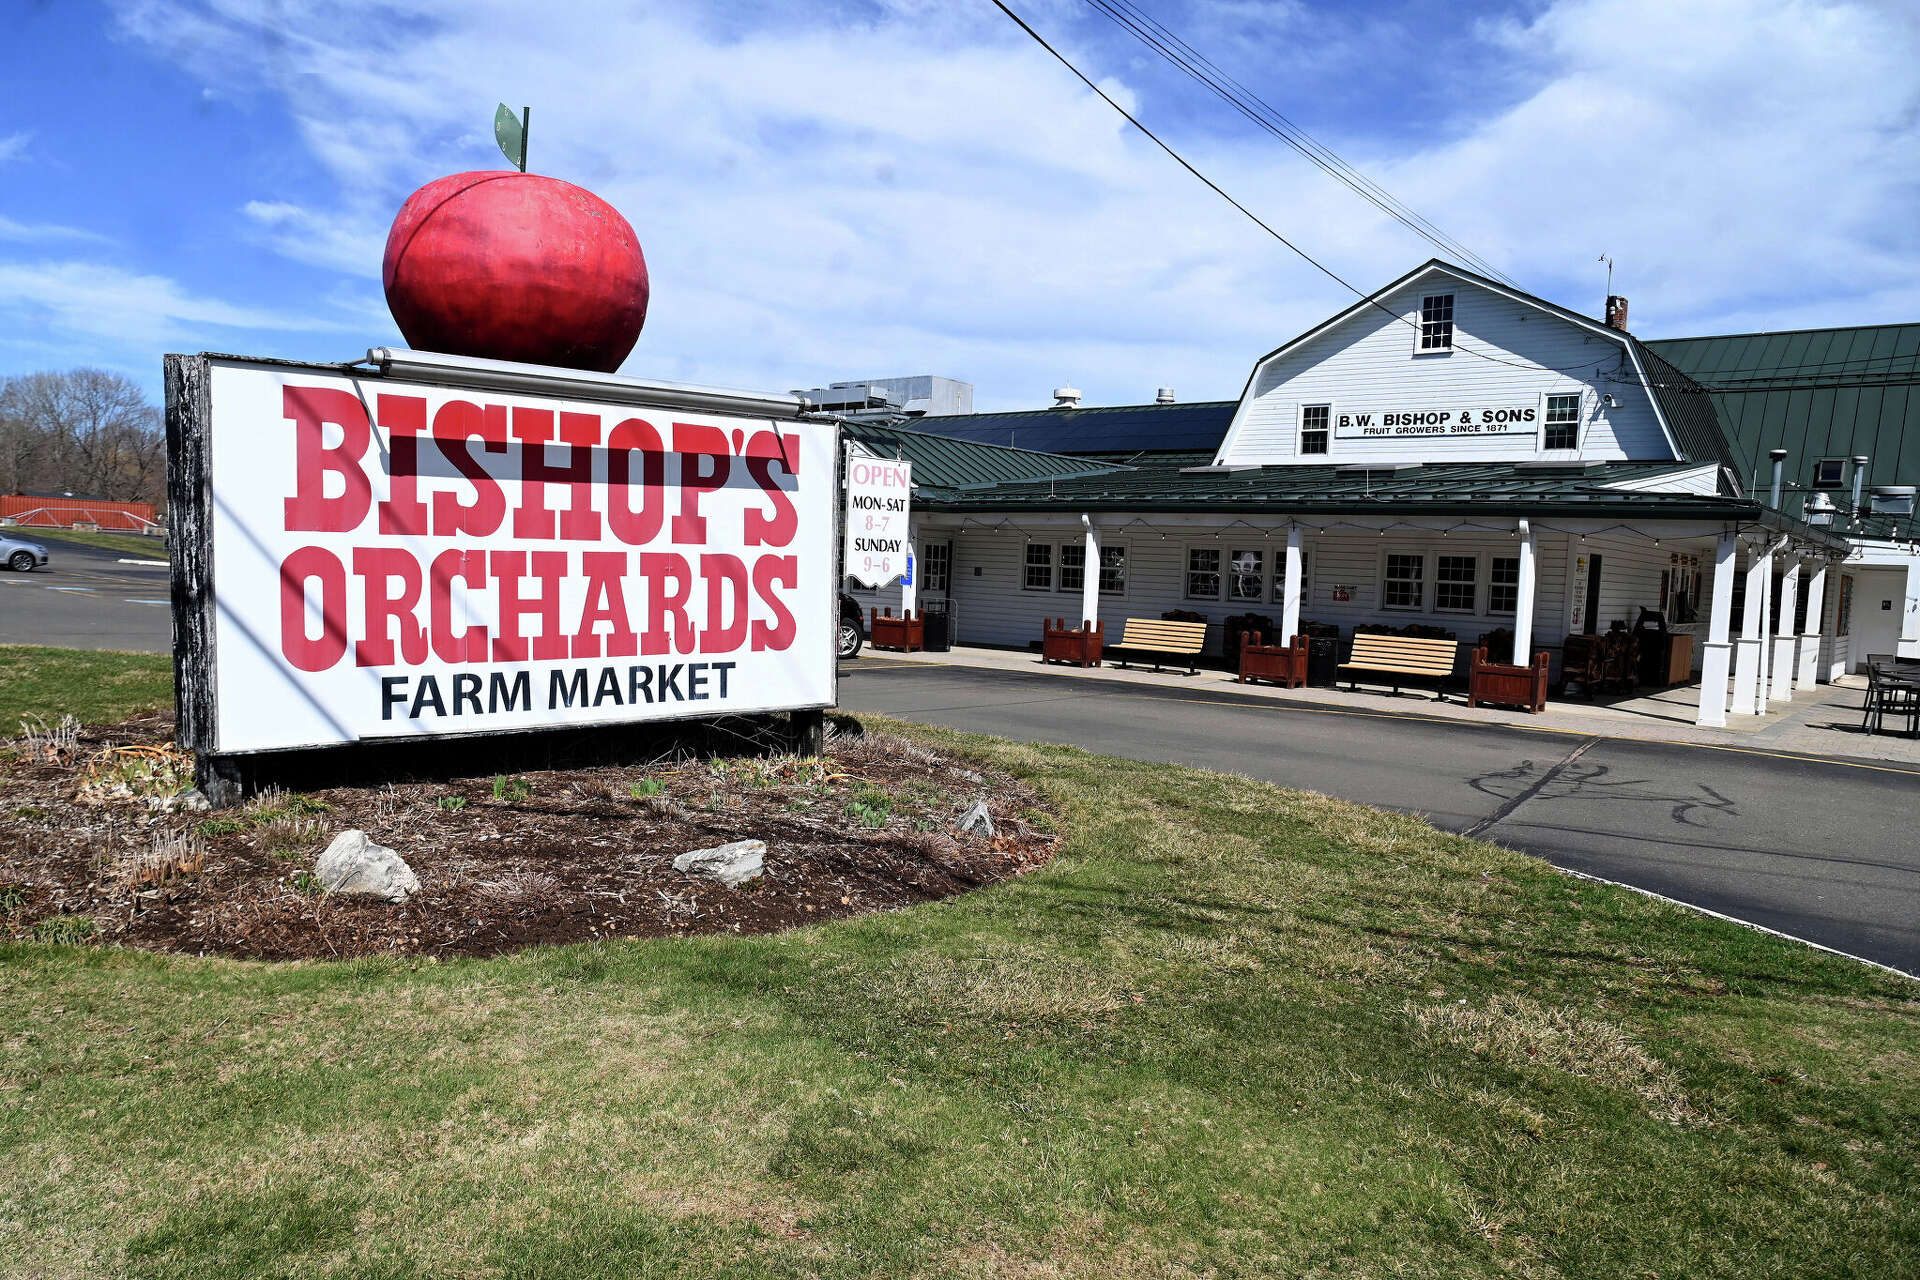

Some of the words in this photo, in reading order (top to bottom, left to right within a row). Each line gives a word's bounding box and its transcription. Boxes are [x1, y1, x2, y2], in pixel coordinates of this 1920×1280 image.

[1339, 414, 1376, 427] B.W.
[1384, 412, 1451, 426] BISHOP
[1460, 411, 1472, 424] &
[1482, 408, 1536, 423] SONS
[1363, 427, 1391, 435] FRUIT
[1395, 426, 1446, 434] GROWERS
[1450, 425, 1482, 433] SINCE
[1486, 424, 1508, 432] 1871
[283, 385, 800, 547] BISHOP'S
[853, 463, 907, 488] OPEN
[852, 496, 906, 512] MON-SAT
[865, 515, 890, 531] 8-7
[854, 537, 902, 553] SUNDAY
[863, 556, 890, 573] 9-6
[280, 545, 799, 672] ORCHARDS
[382, 670, 531, 720] FARM
[548, 661, 736, 710] MARKET
